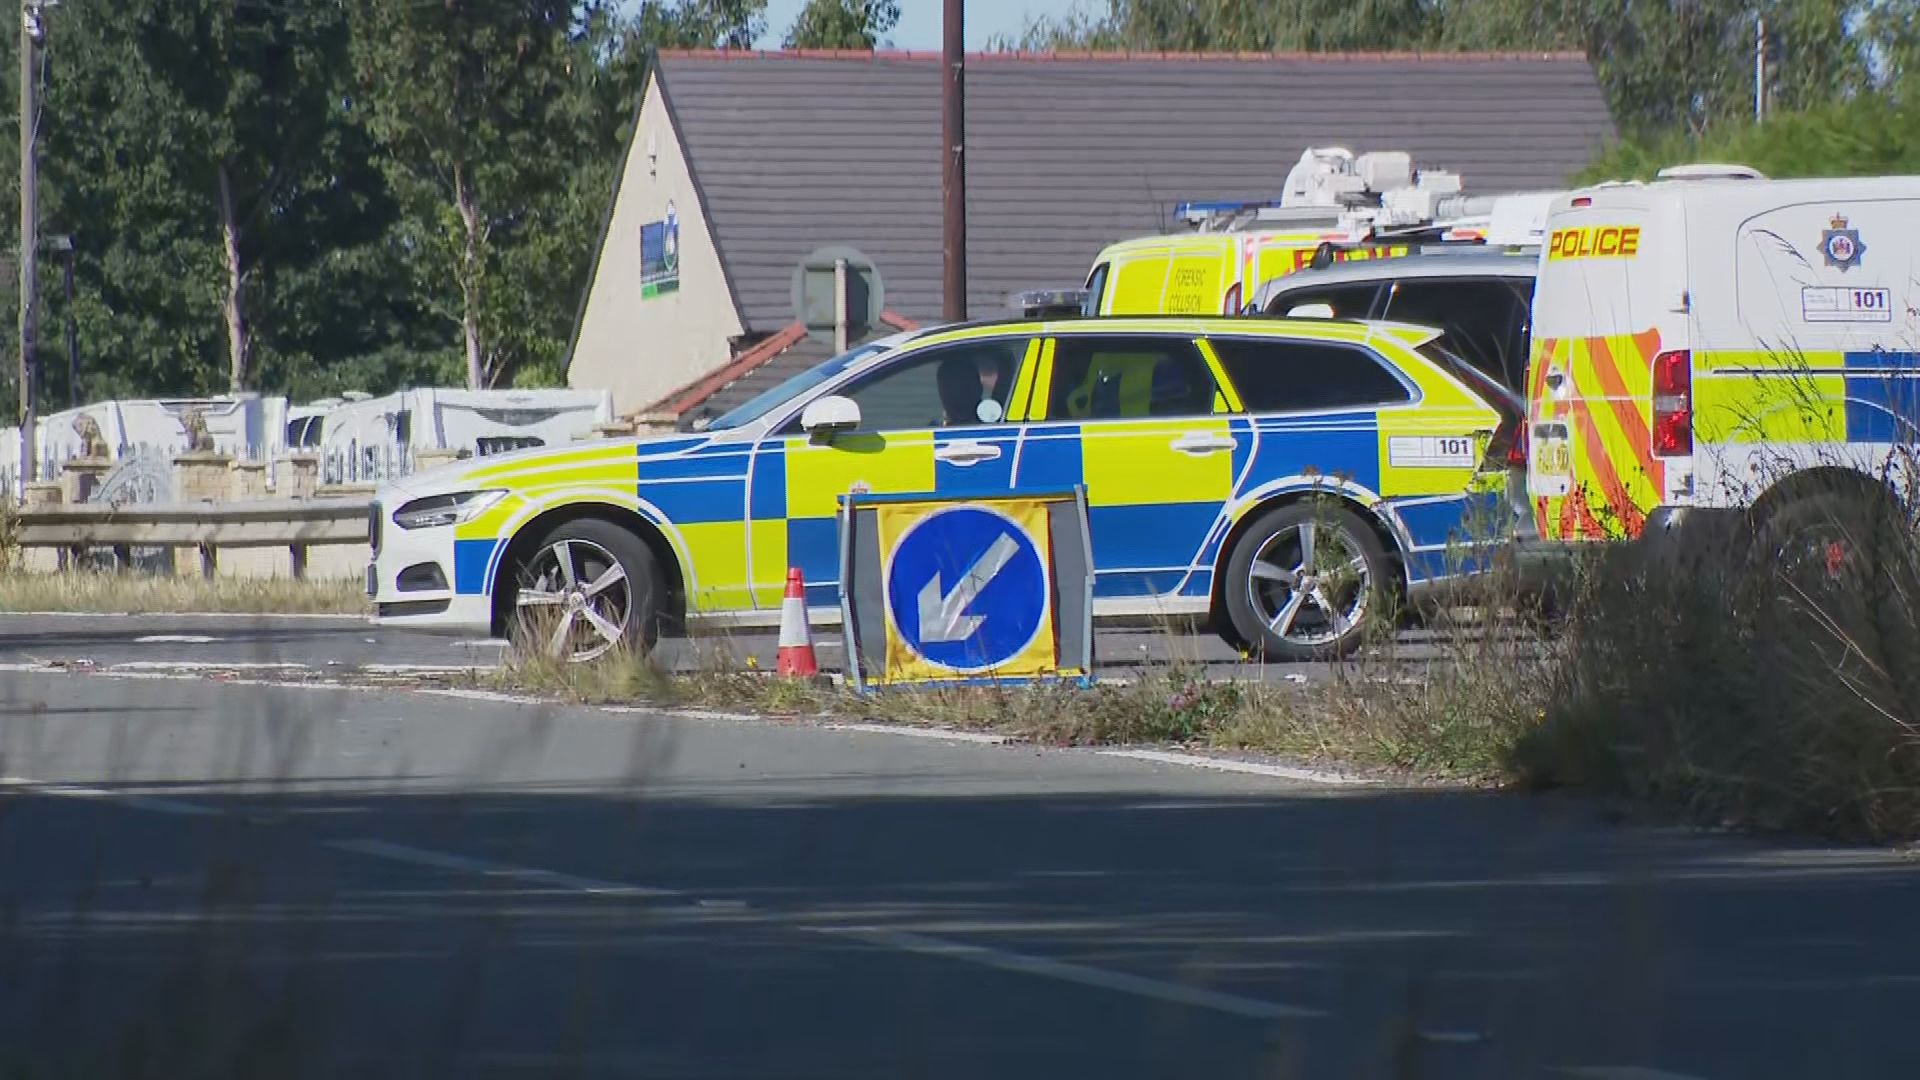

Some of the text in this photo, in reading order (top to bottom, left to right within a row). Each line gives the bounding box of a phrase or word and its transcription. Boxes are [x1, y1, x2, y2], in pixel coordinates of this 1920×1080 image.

[1549, 228, 1640, 259] POLICE
[1854, 291, 1883, 308] 101
[1440, 440, 1468, 455] 101
